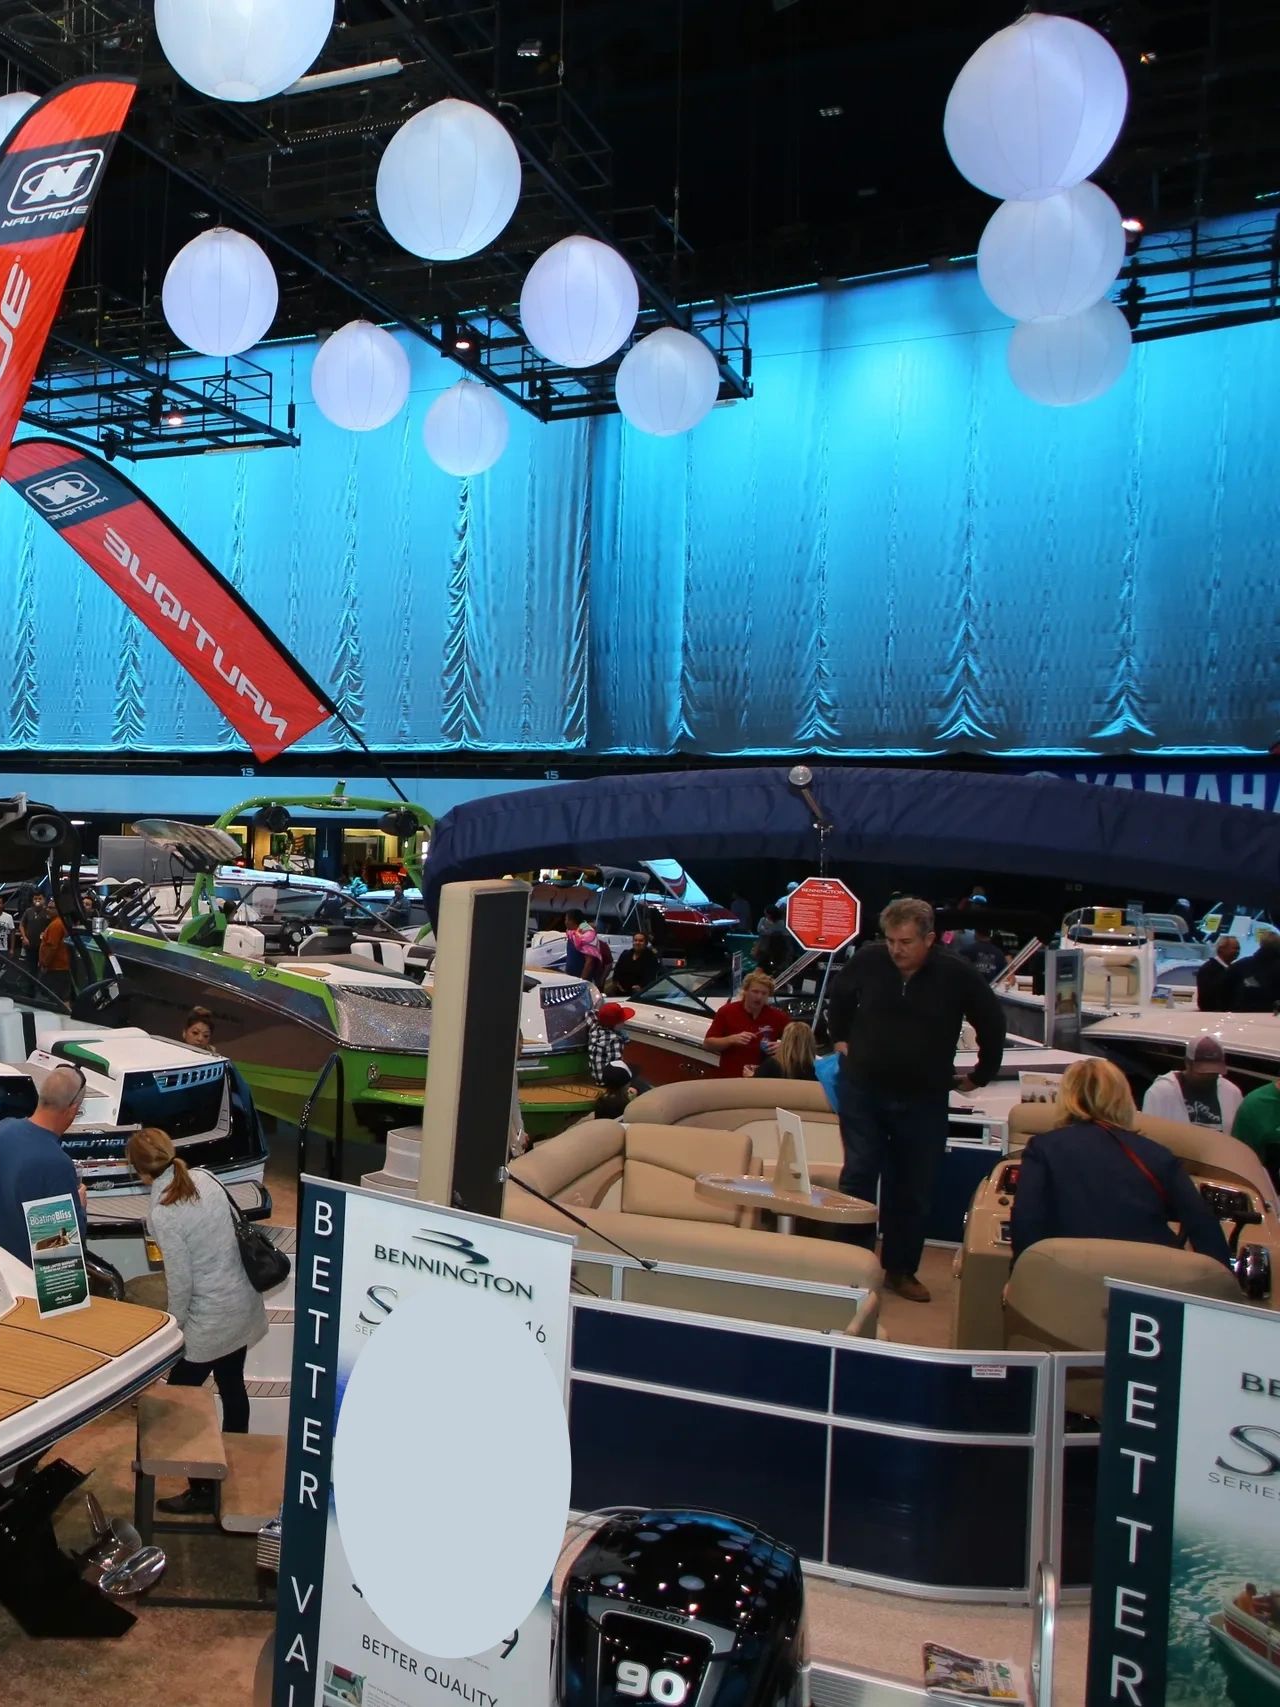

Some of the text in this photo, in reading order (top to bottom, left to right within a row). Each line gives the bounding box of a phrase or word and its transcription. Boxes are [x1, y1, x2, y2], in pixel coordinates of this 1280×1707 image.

[1, 205, 90, 229] NAUTIQUE
[240, 766, 255, 777] 13
[543, 770, 560, 781] 15
[60, 1138, 128, 1148] NAUTIQU
[374, 1244, 533, 1300] BENNINGTON
[298, 1200, 334, 1509] BETTER
[1110, 1312, 1161, 1706] BETTER
[627, 1604, 688, 1625] MERCURY
[361, 1634, 419, 1675] BETTER
[424, 1666, 498, 1707] QUALITY
[616, 1660, 687, 1706] 90
